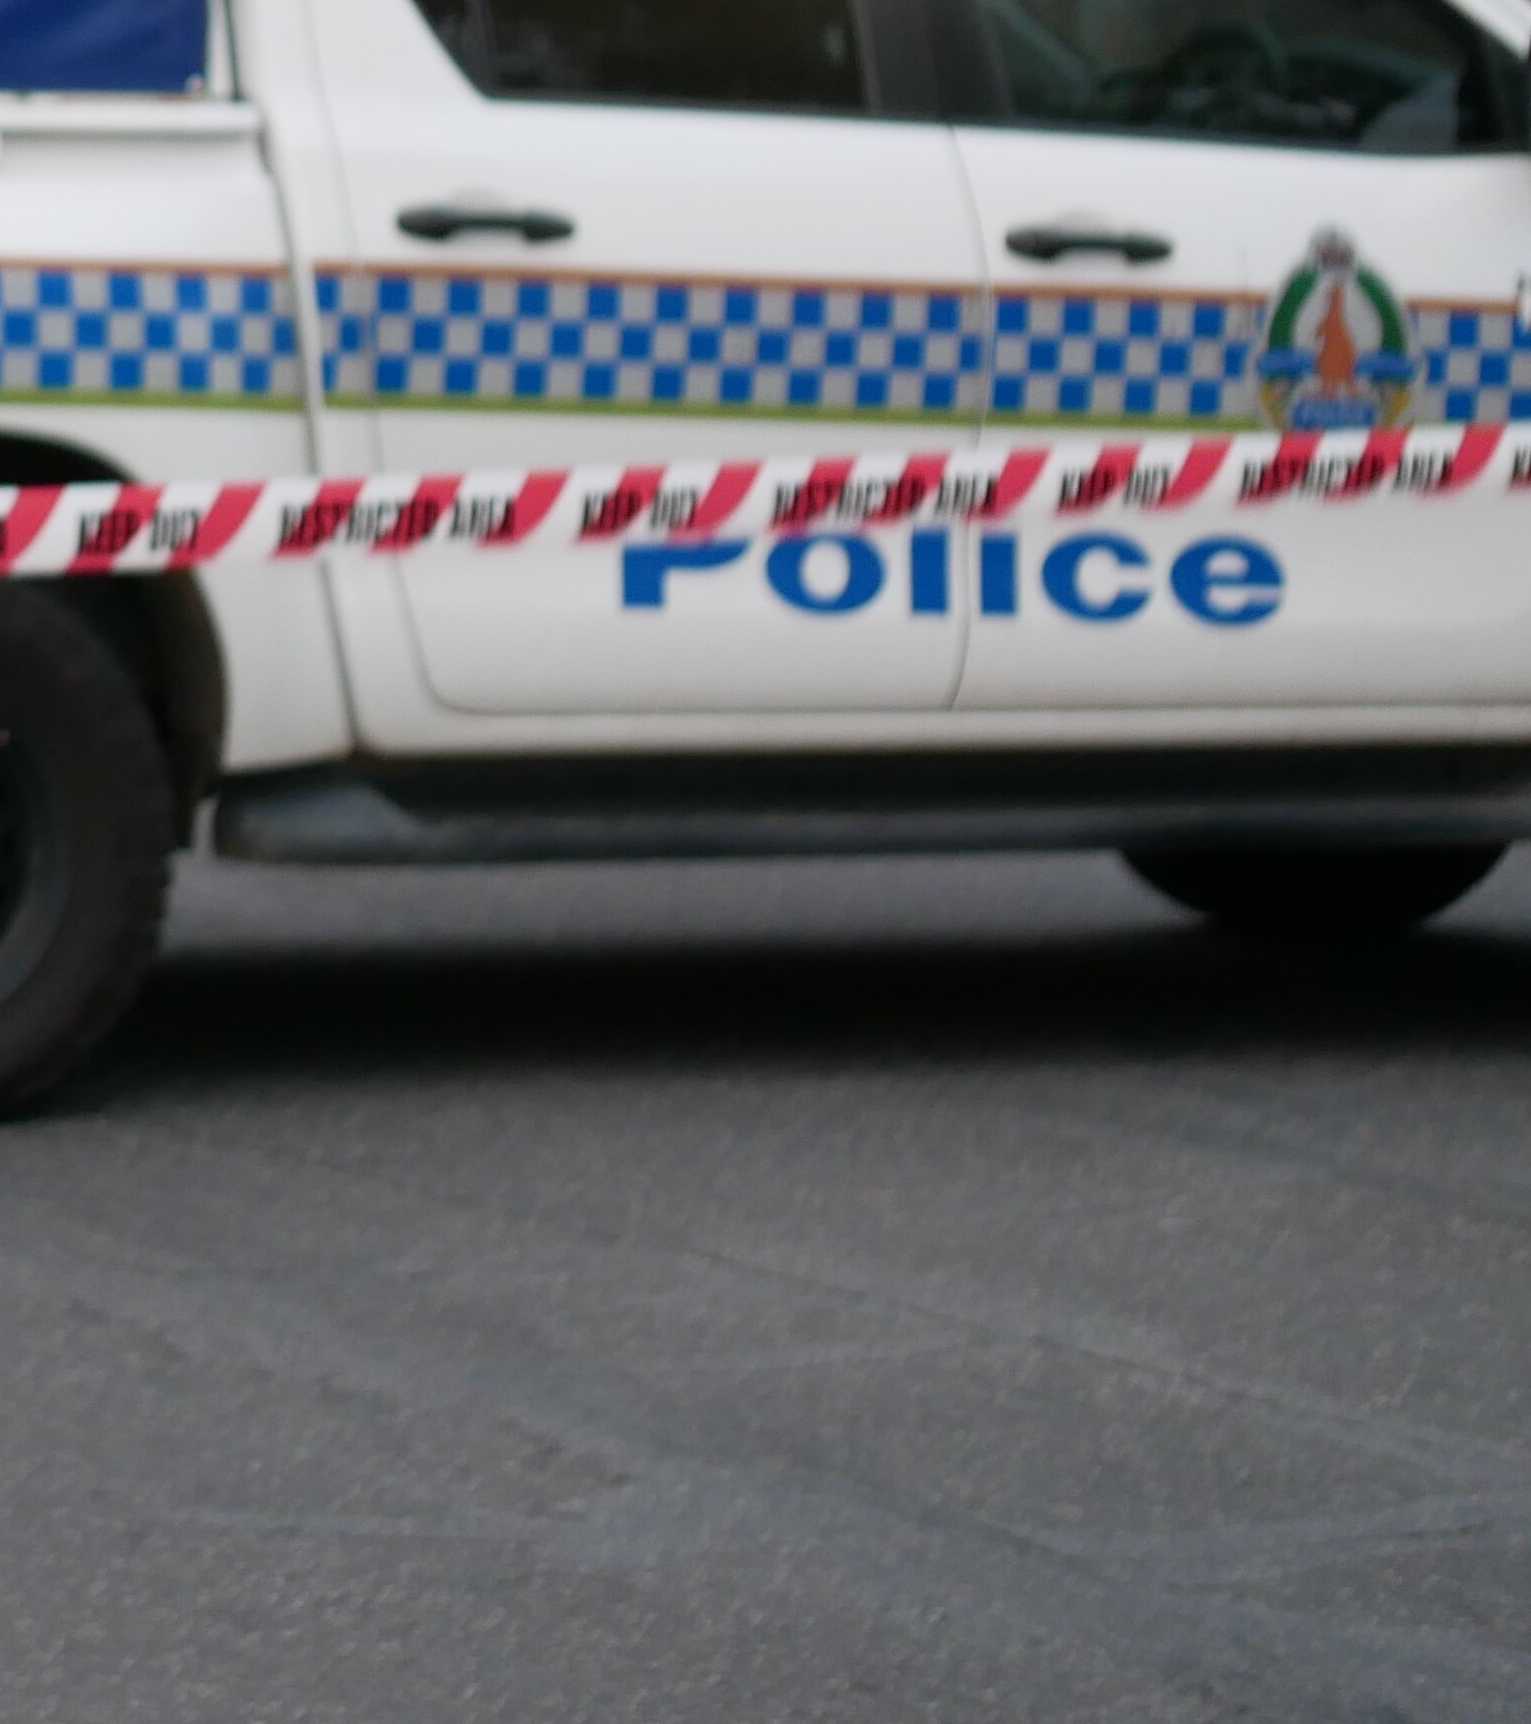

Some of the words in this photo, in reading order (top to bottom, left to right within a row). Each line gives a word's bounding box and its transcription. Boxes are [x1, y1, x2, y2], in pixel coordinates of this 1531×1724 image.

[79, 511, 141, 556] KEEP
[151, 508, 200, 553] OUT
[623, 527, 1283, 626] Police
